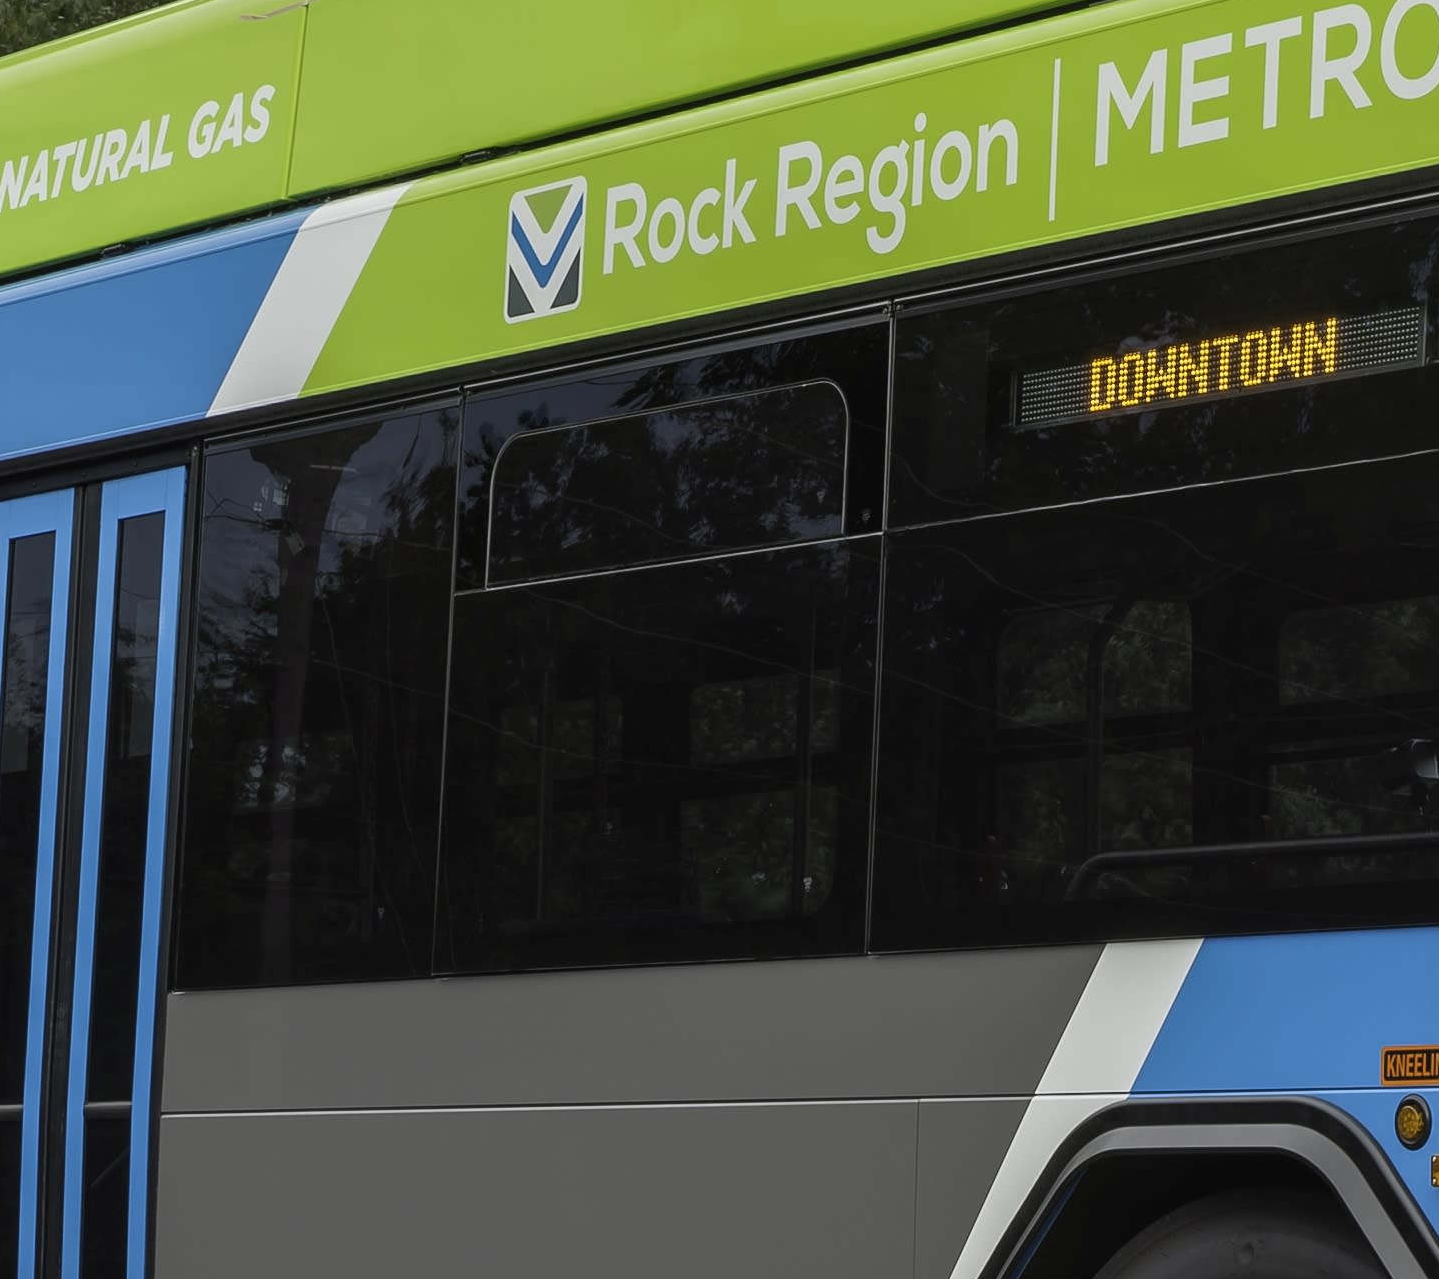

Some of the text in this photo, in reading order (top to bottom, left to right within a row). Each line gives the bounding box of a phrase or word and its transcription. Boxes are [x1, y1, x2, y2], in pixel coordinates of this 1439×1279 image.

[187, 84, 276, 159] GAS
[602, 159, 757, 275] Rock
[774, 112, 1019, 254] Region
[1088, 317, 1339, 413] DOWNTOWN
